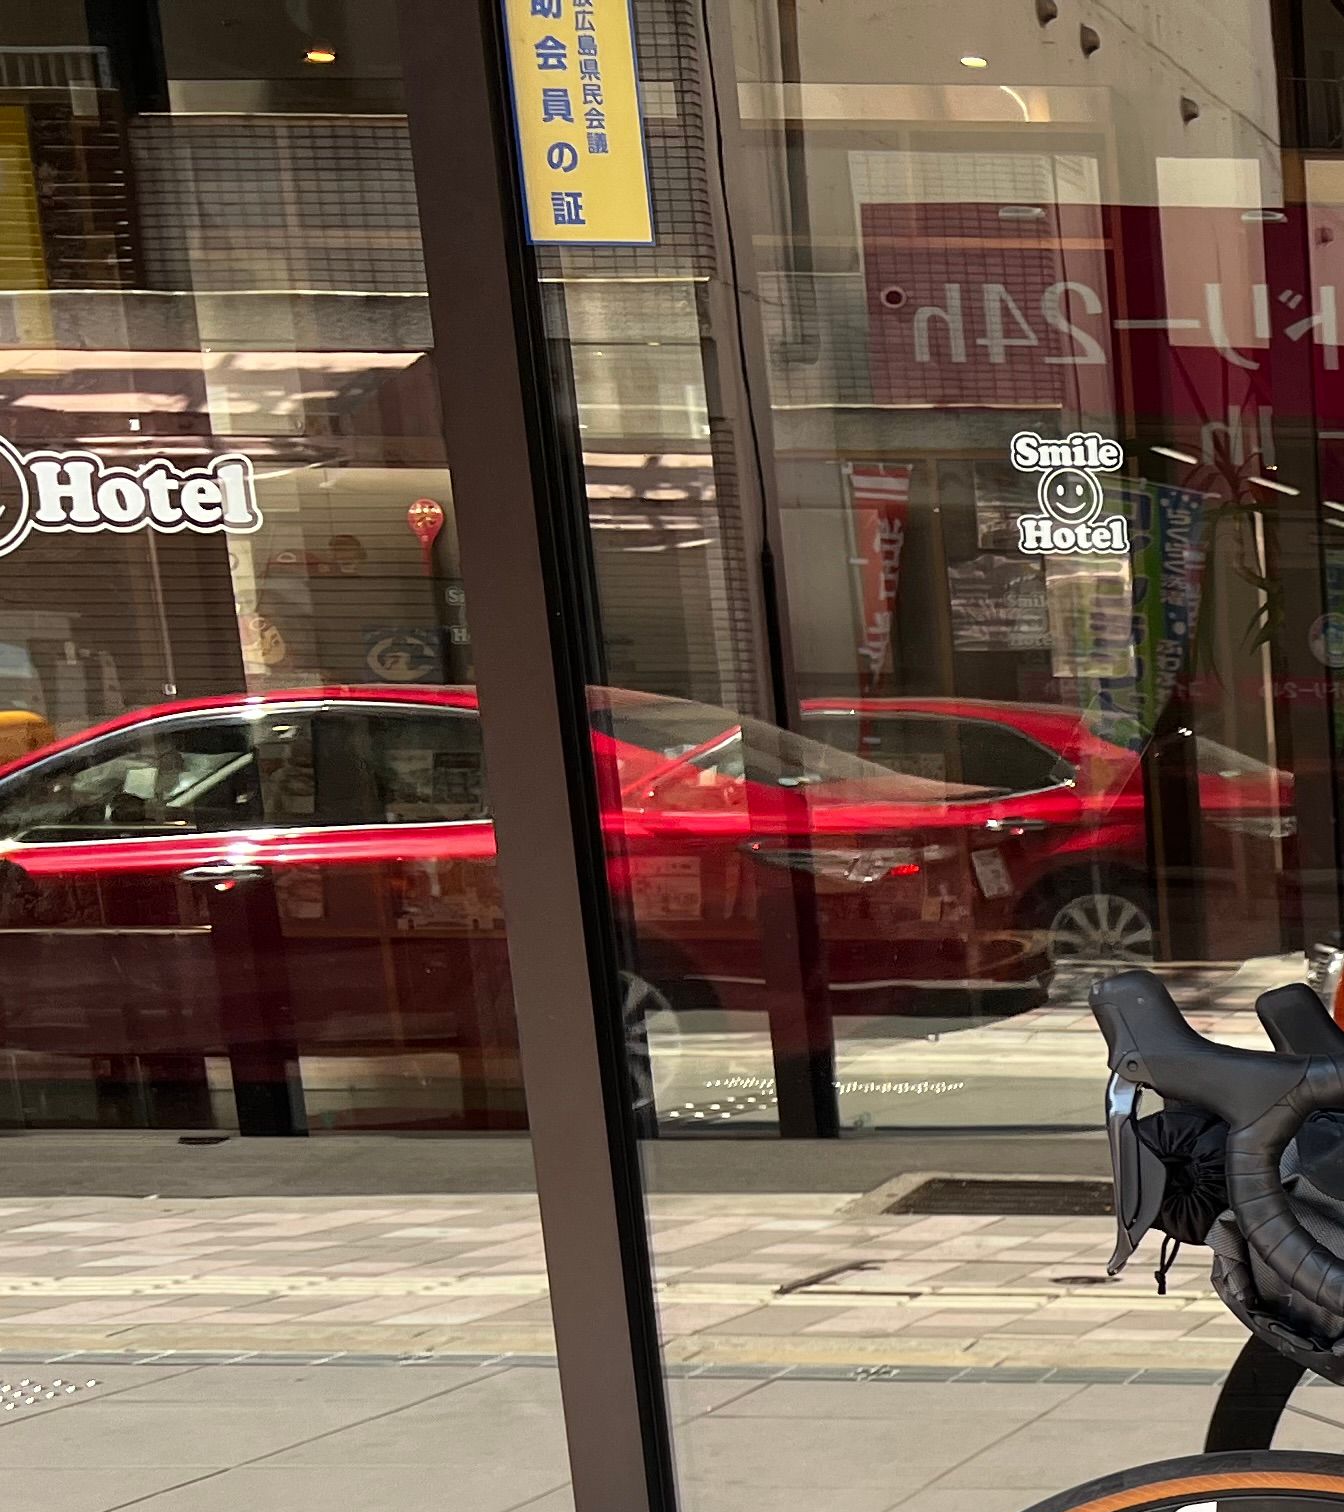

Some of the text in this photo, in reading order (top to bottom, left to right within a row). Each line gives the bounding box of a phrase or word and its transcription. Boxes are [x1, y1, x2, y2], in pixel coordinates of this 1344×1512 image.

[1013, 434, 1121, 468] Smile
[29, 460, 254, 524] Hotel
[1020, 518, 1127, 551] Hotel
